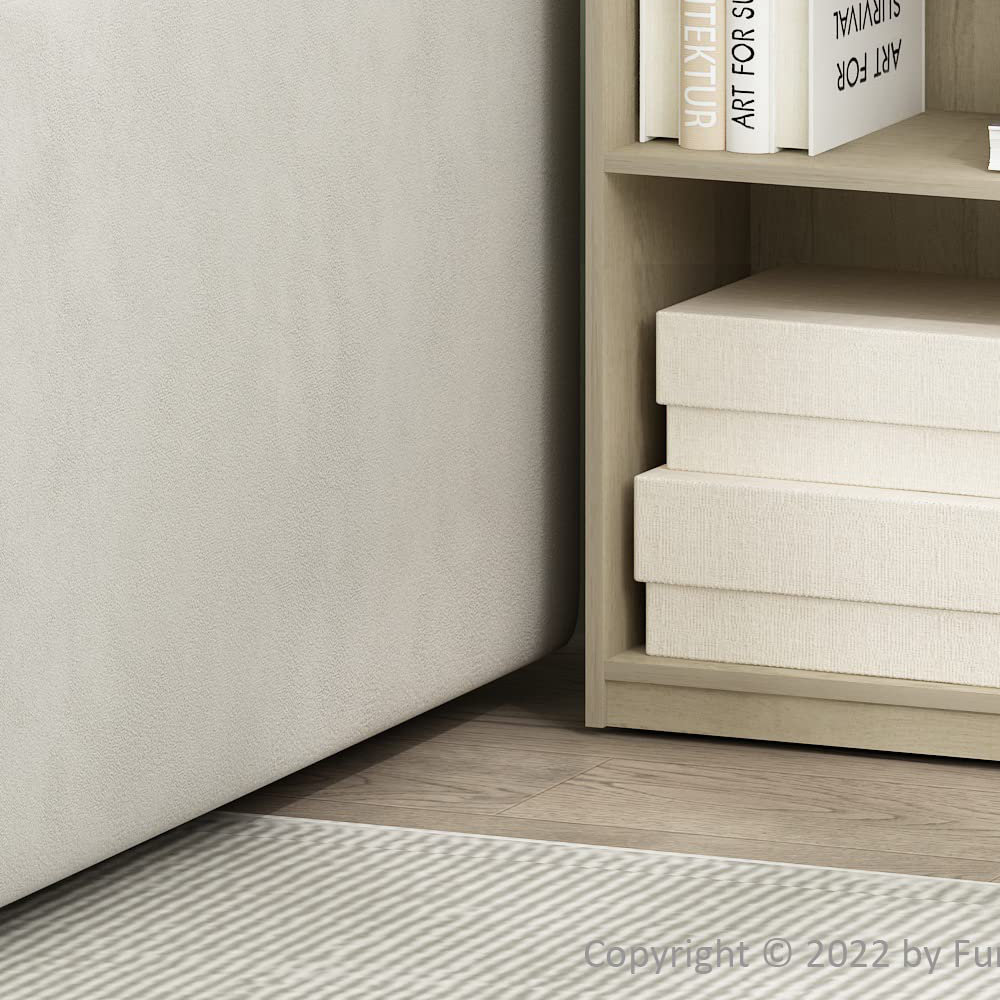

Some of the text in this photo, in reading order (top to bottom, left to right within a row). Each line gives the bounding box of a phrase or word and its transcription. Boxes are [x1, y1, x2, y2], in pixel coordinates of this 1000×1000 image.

[731, 28, 756, 76] FOR
[836, 38, 902, 92] ART FOR
[731, 84, 756, 130] ART
